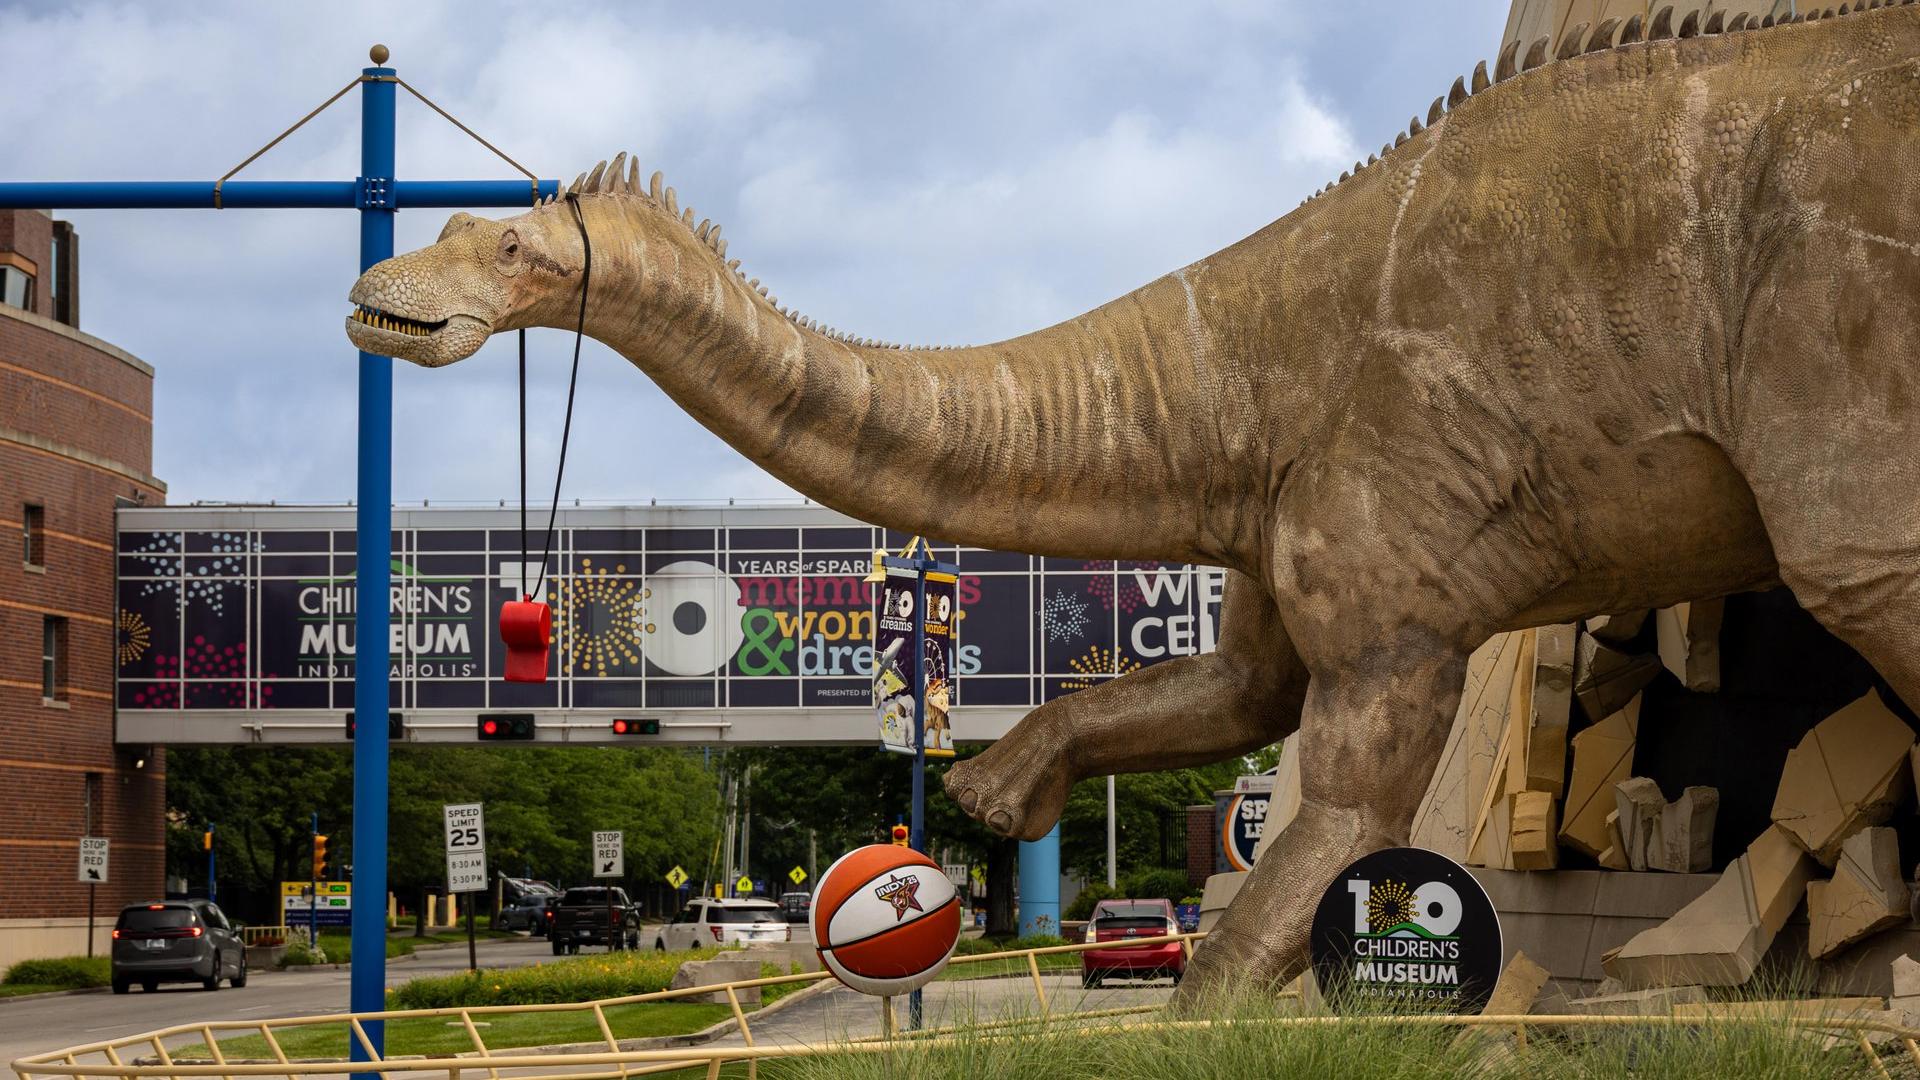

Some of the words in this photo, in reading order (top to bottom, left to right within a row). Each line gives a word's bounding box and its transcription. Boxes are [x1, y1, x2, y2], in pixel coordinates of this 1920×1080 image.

[738, 560, 799, 574] YEARS
[802, 562, 813, 571] of
[298, 585, 472, 614] CHIREN'S
[880, 616, 913, 632] dreams
[924, 623, 949, 635] wonder
[299, 623, 471, 654] MUEUM
[737, 608, 795, 676] &
[774, 610, 966, 640] wonr
[798, 633, 982, 675] dres
[298, 663, 471, 678] INDIAPOLIS
[817, 689, 859, 697] PRESENTED
[861, 689, 871, 697] BY
[448, 808, 479, 818] SPEED
[451, 818, 476, 827] LIMIT
[450, 828, 479, 847] 25
[597, 833, 620, 842] STOP
[82, 840, 107, 849] STOP
[84, 856, 103, 865] RED
[599, 849, 618, 859] RED
[470, 859, 481, 867] AM
[471, 874, 482, 882] PM
[876, 879, 906, 897] INDY
[1354, 938, 1459, 959] CHILDREN'S
[1354, 962, 1458, 984] MUSEUM
[1355, 987, 1459, 999] NDIANAPOLIS
